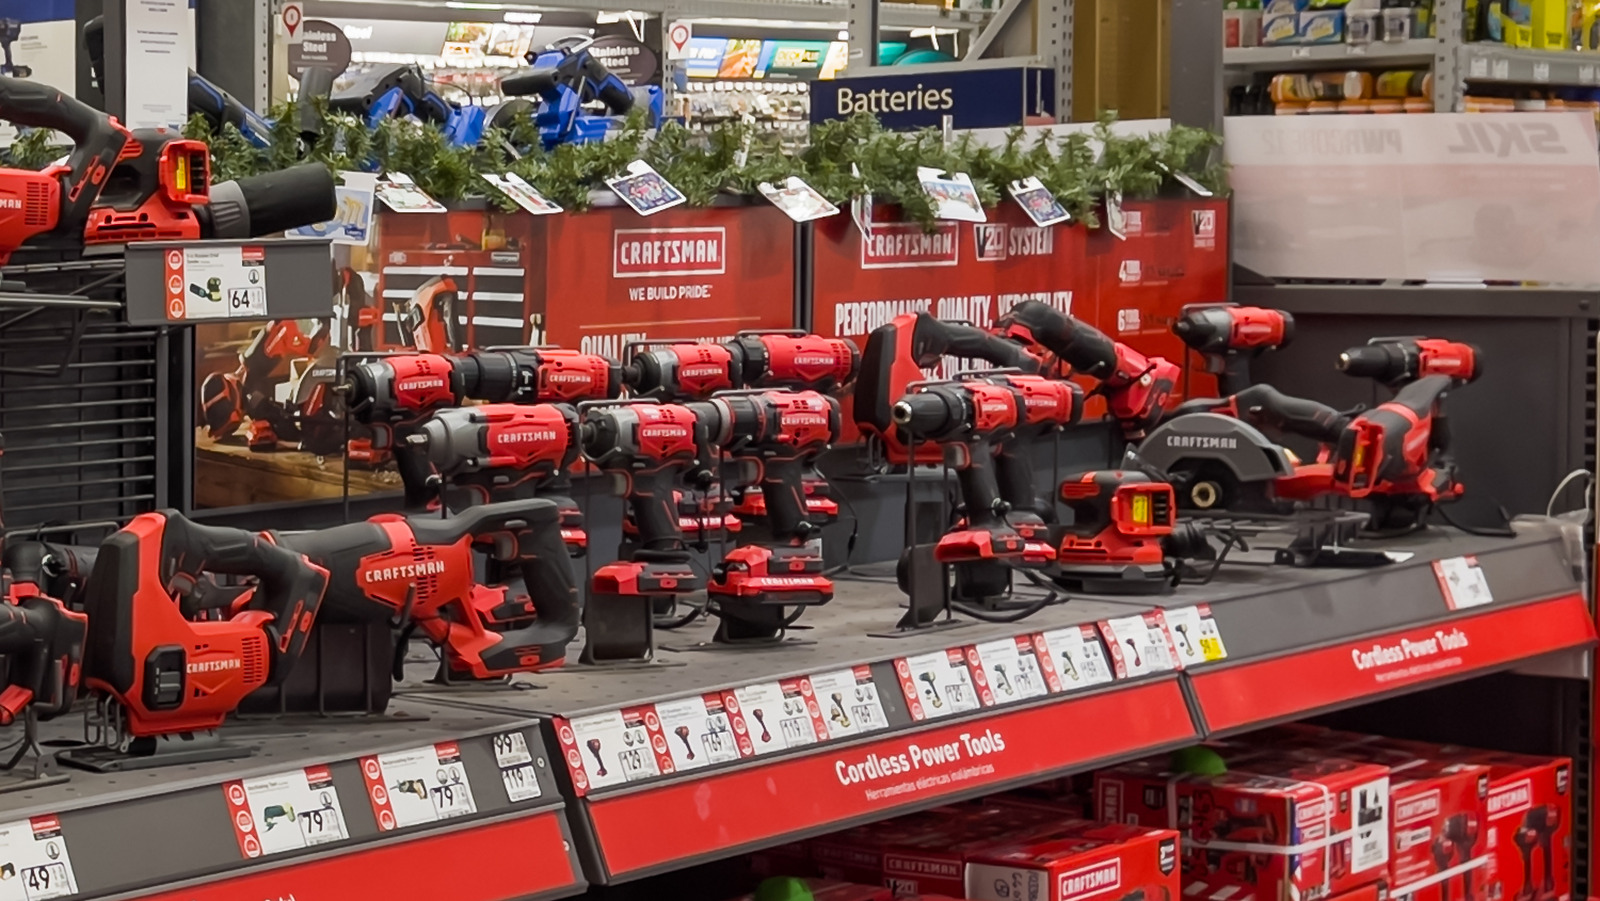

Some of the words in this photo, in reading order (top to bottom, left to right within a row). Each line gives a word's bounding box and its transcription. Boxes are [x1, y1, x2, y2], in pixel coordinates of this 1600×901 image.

[302, 31, 336, 42] ainless
[303, 42, 328, 53] Steel
[838, 83, 954, 114] Batteries
[867, 232, 955, 257] CRAFTSMAN
[1009, 226, 1053, 255] SYSTEM
[621, 239, 718, 266] CRAFTSMAN
[232, 289, 250, 309] 64
[629, 287, 646, 301] WE
[647, 286, 678, 301] BUILD
[795, 355, 835, 365] CRAFTSMAN
[548, 374, 592, 384] CRAFTSMAN
[682, 367, 723, 378] CRAFTSMAN
[398, 380, 444, 391] CRAFTSMAN
[781, 416, 827, 426] CRAFTSMAN
[497, 430, 557, 444] CRAFTSMAN
[642, 428, 688, 438] CRAFTSMAN
[1166, 435, 1238, 450] CRAFTSMAN
[365, 560, 446, 584] CRAFTSMAN
[186, 658, 242, 675] CRAFTSMAN
[1351, 644, 1405, 671] Cordless
[496, 734, 512, 755] 99
[835, 753, 911, 786] Cordless
[908, 741, 961, 770] Power
[959, 728, 1006, 758] Tools
[433, 786, 453, 809] 79
[302, 810, 323, 834] 79
[889, 858, 957, 876] CRAFTSMAN
[28, 867, 50, 891] 49
[1062, 866, 1117, 897] CRAFTSMAN
